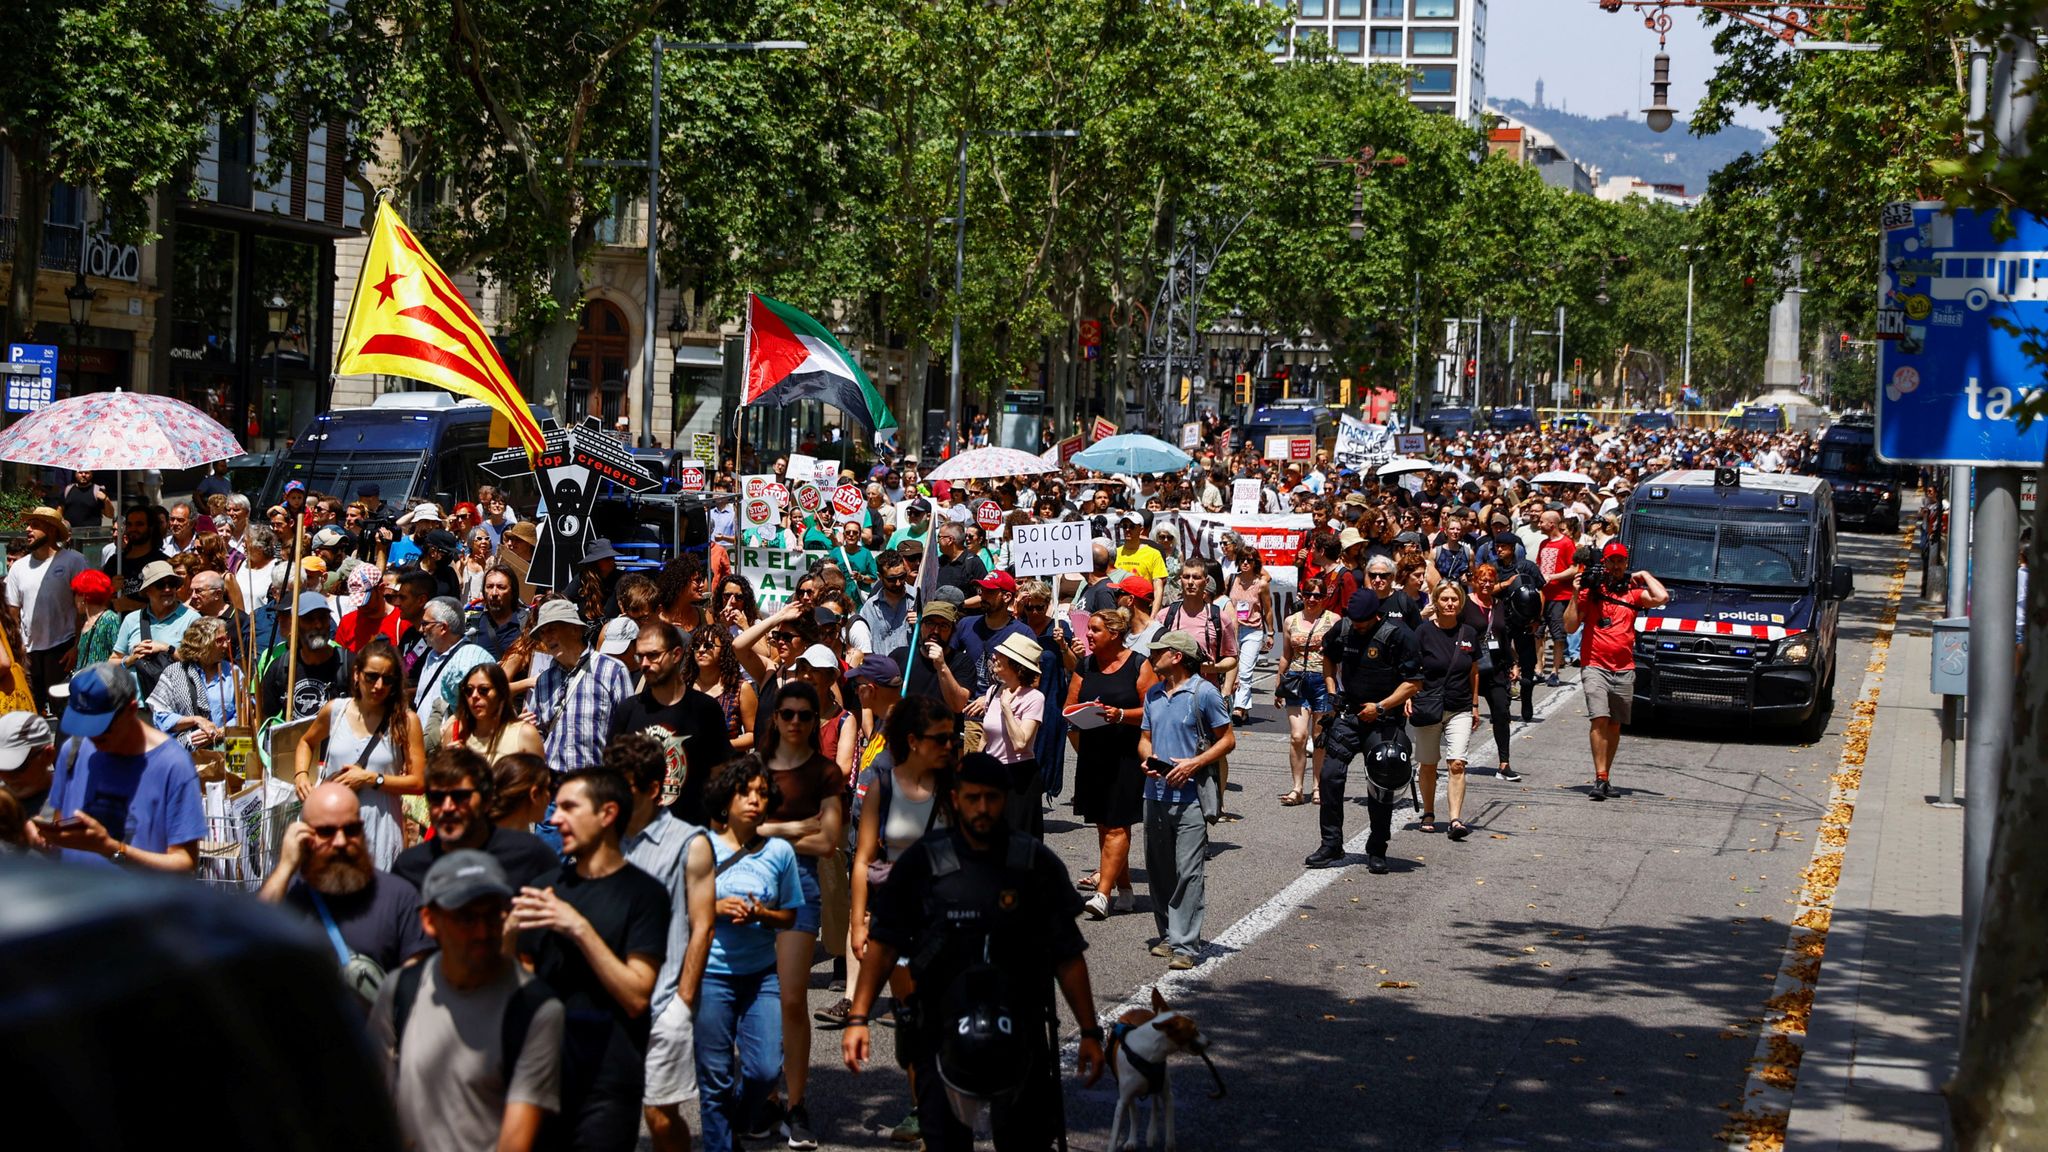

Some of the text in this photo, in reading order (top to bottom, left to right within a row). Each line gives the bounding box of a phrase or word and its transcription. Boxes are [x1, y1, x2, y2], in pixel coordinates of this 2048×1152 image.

[12, 346, 24, 362] P
[533, 453, 637, 487] top creuers
[682, 474, 702, 483] STOP
[762, 489, 787, 500] STOP
[801, 490, 816, 503] STOP
[836, 487, 861, 507] STOP
[749, 505, 766, 514] STOP
[979, 507, 1000, 519] STOP
[1017, 524, 1084, 544] BOICOT
[768, 551, 796, 570] EL
[1020, 545, 1084, 569] Airbnb
[1719, 612, 1768, 622] policia
